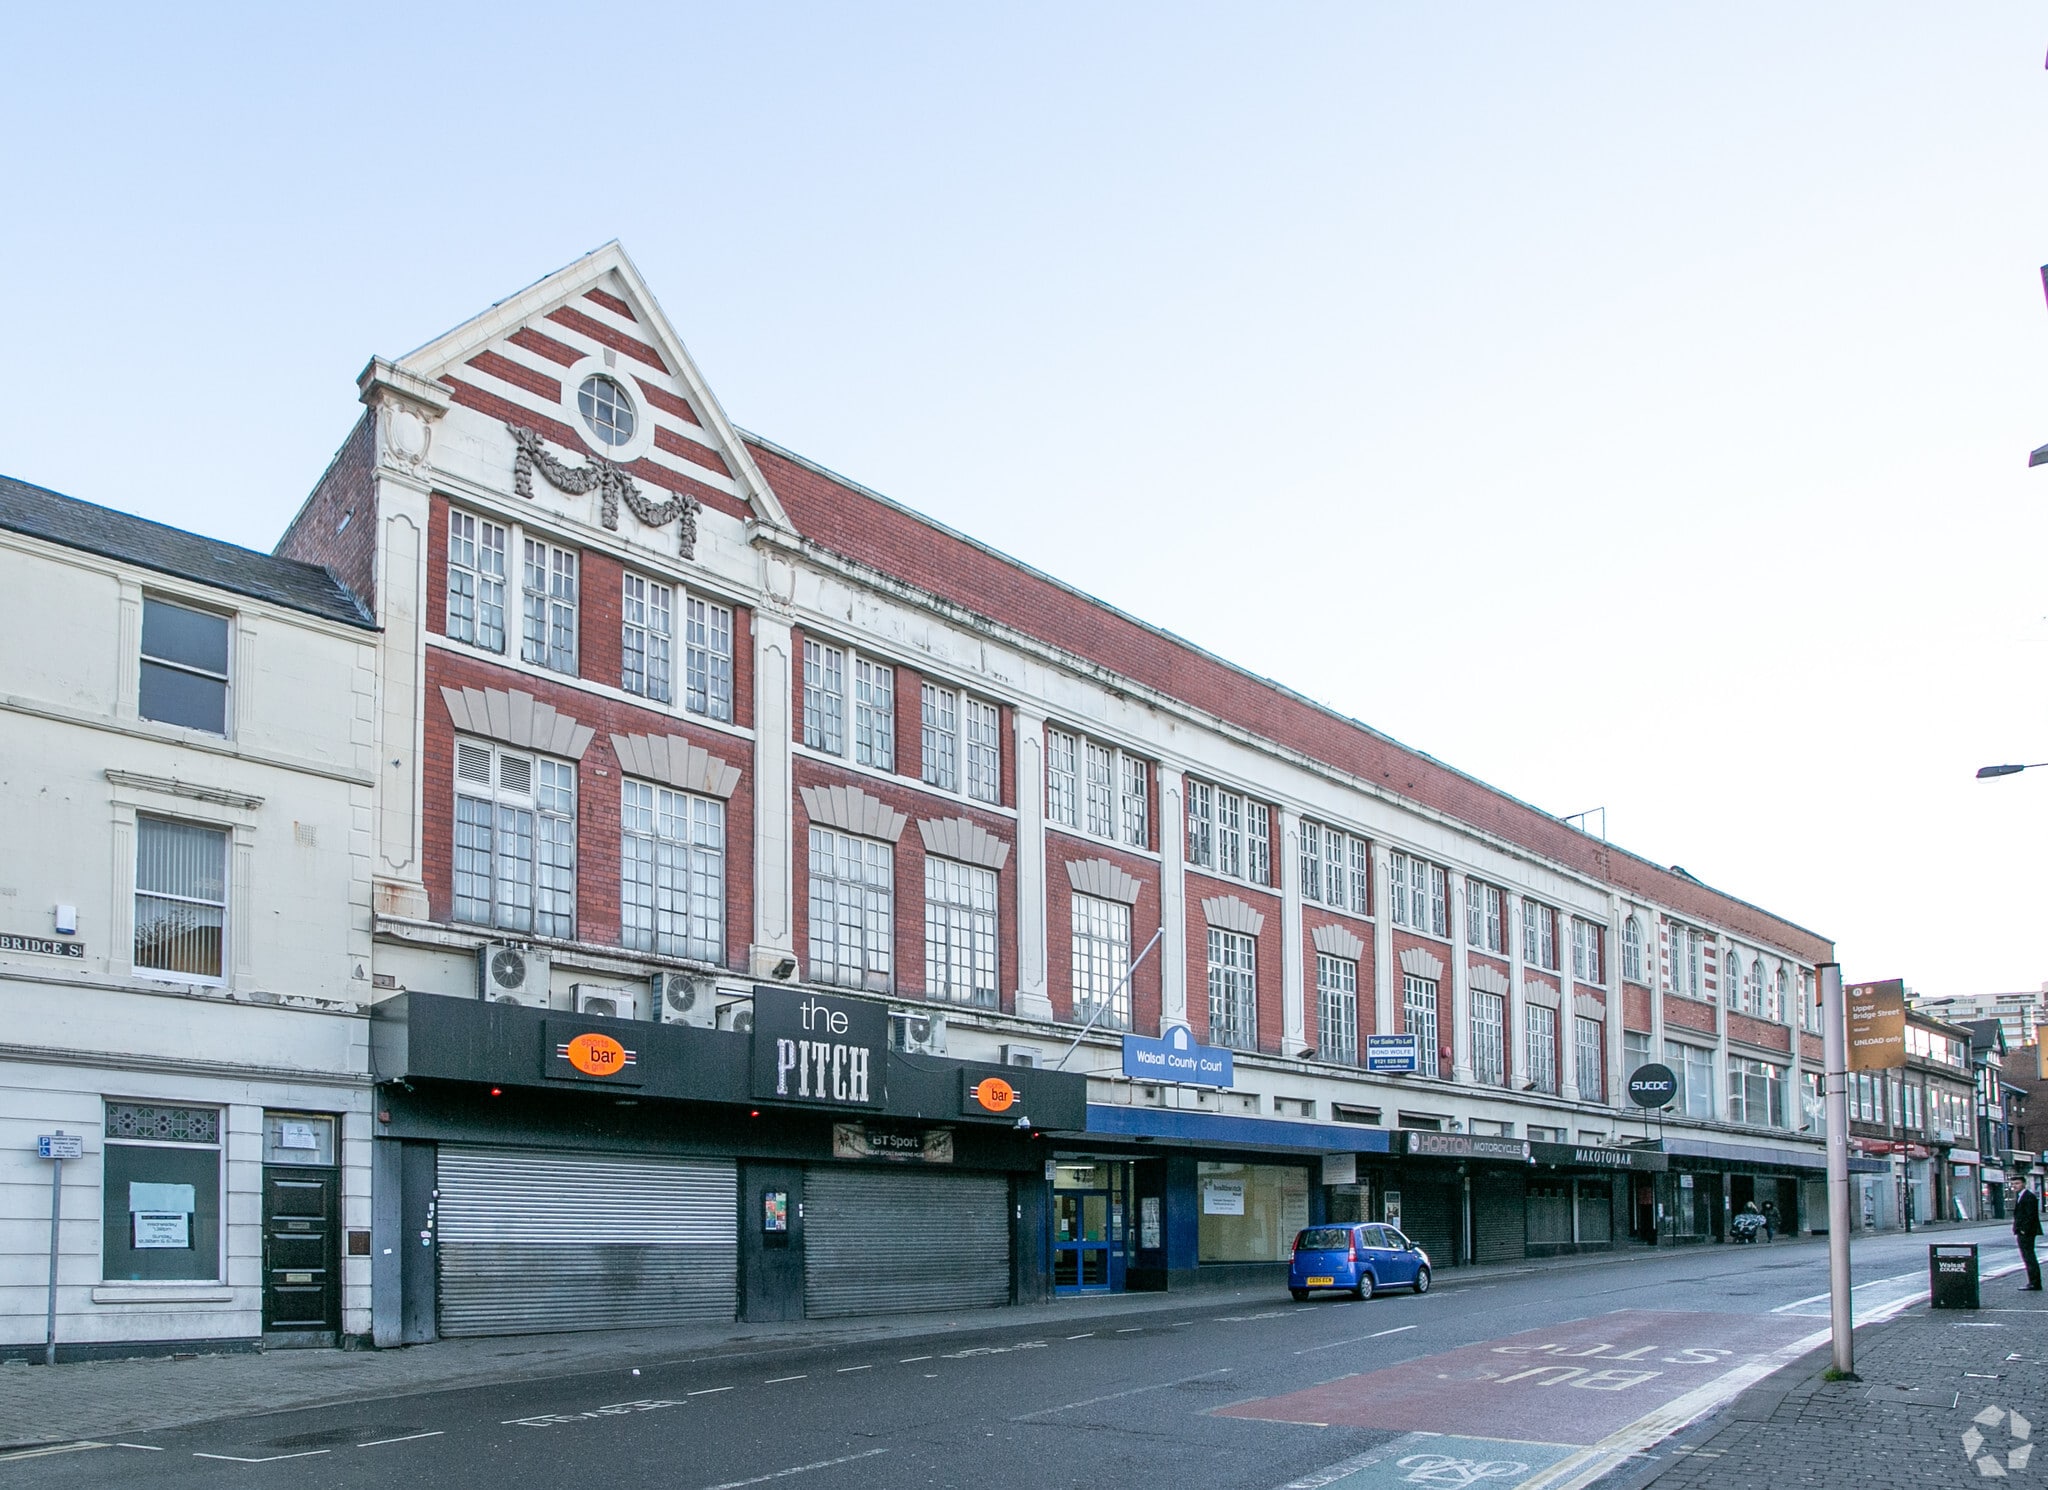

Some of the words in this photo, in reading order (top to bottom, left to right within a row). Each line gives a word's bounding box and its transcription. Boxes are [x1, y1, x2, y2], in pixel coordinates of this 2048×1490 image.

[0, 936, 62, 954] BRIDGE
[800, 997, 848, 1034] the
[1852, 1004, 1875, 1013] Upper
[1852, 1011, 1876, 1020] Bridge
[1877, 1008, 1900, 1017] Street
[581, 1038, 609, 1048] sports
[1853, 1037, 1884, 1047] UNLOAD
[1885, 1035, 1902, 1044] only
[590, 1046, 616, 1063] bar
[1136, 1050, 1166, 1065] Walsall
[1168, 1054, 1198, 1071] County
[1200, 1059, 1223, 1072] Court
[776, 1038, 869, 1102] PITCH
[991, 1088, 1008, 1101] bar
[873, 1135, 889, 1146] BT
[890, 1134, 918, 1148] Sport
[1421, 1135, 1472, 1154] HORTON
[1473, 1142, 1521, 1154] MOTORCYCLES
